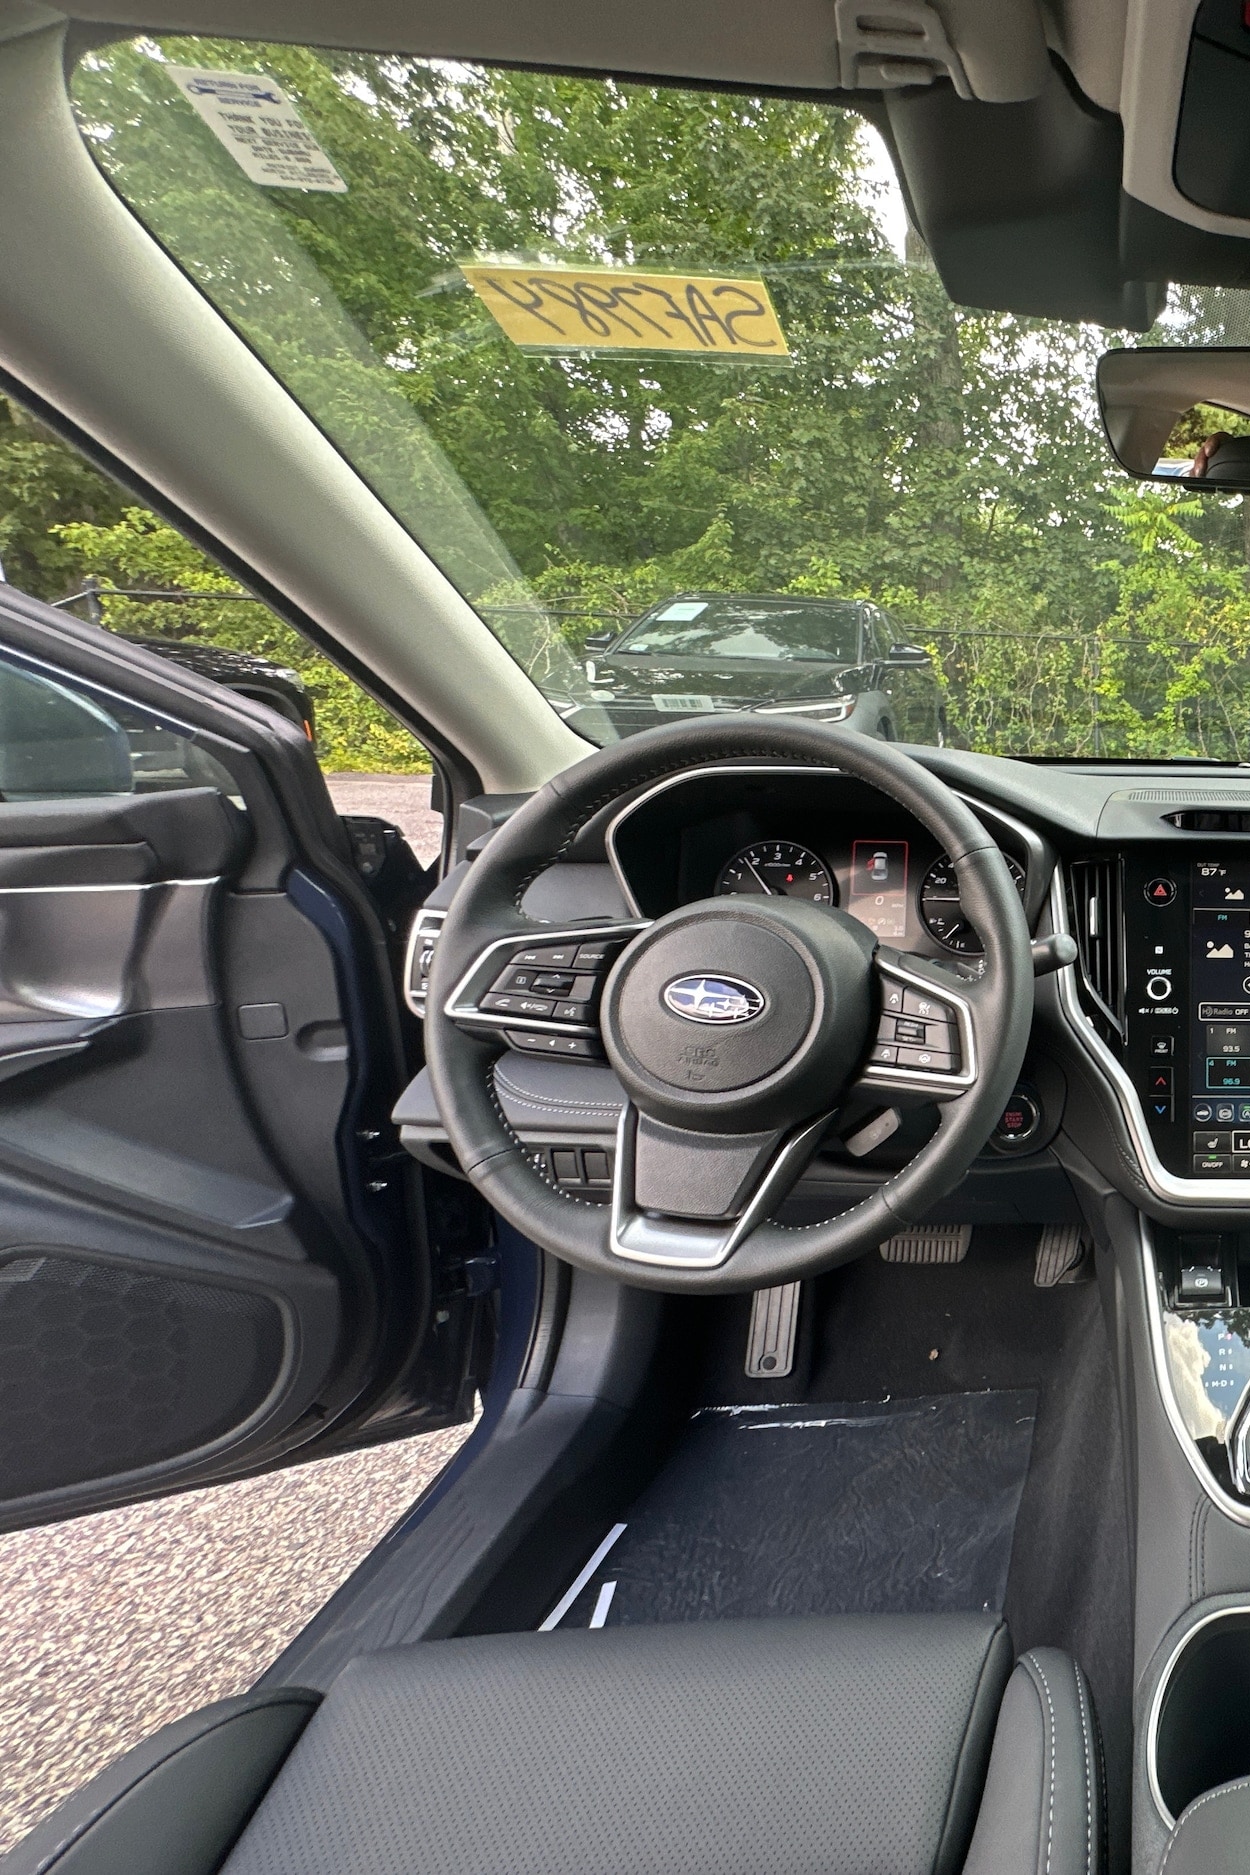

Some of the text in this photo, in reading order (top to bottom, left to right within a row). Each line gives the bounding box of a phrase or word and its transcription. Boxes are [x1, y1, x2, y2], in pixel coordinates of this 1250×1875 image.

[258, 116, 282, 127] YOU
[227, 124, 256, 134] YOUR
[752, 858, 760, 866] 2
[1201, 868, 1217, 876] 87
[875, 896, 884, 906] 0
